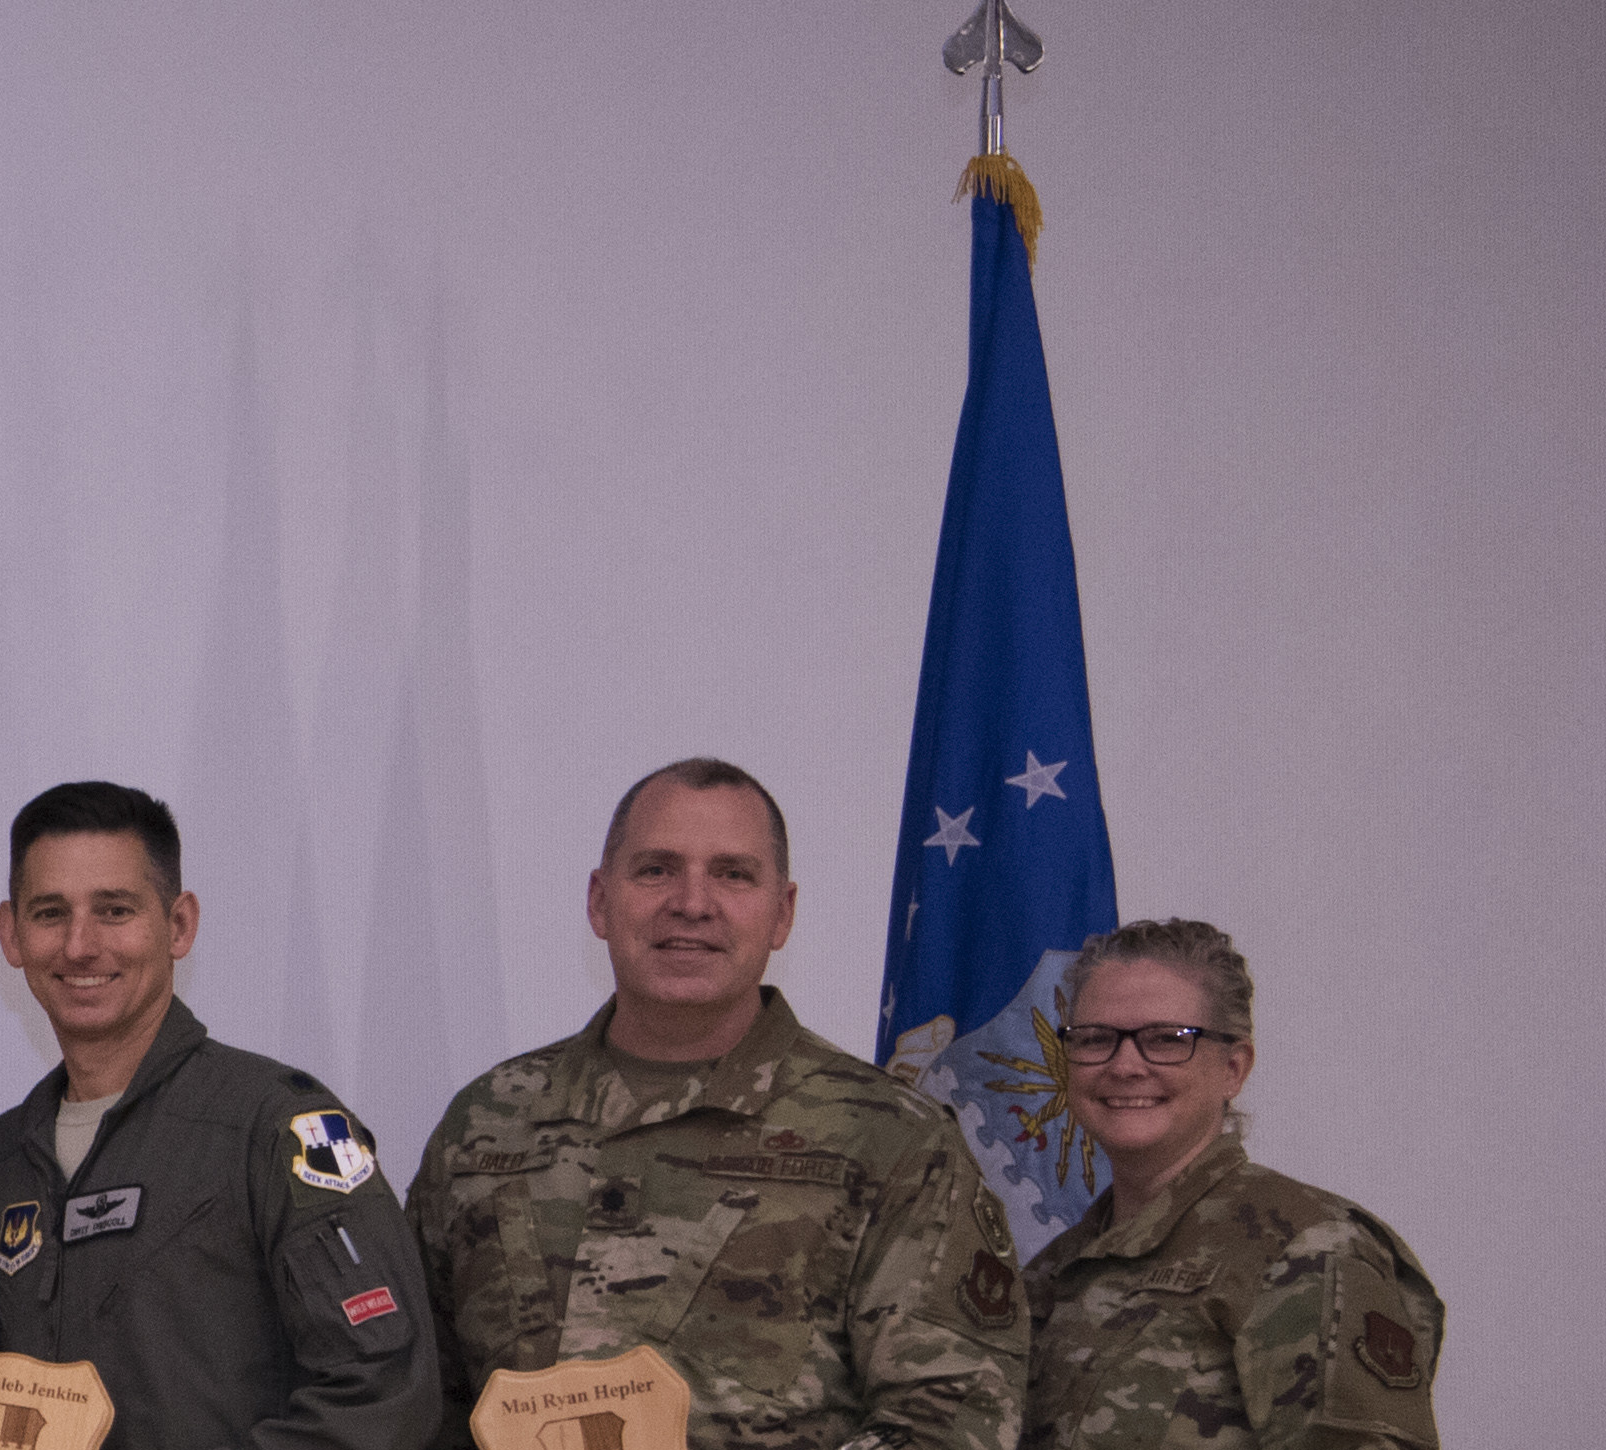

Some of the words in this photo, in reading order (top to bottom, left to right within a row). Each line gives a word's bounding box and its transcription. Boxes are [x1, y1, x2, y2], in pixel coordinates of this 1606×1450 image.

[28, 1383, 88, 1404] Jenkins
[501, 1396, 537, 1416] Maj
[543, 1390, 588, 1410] Ryan
[594, 1379, 654, 1401] Hepler
